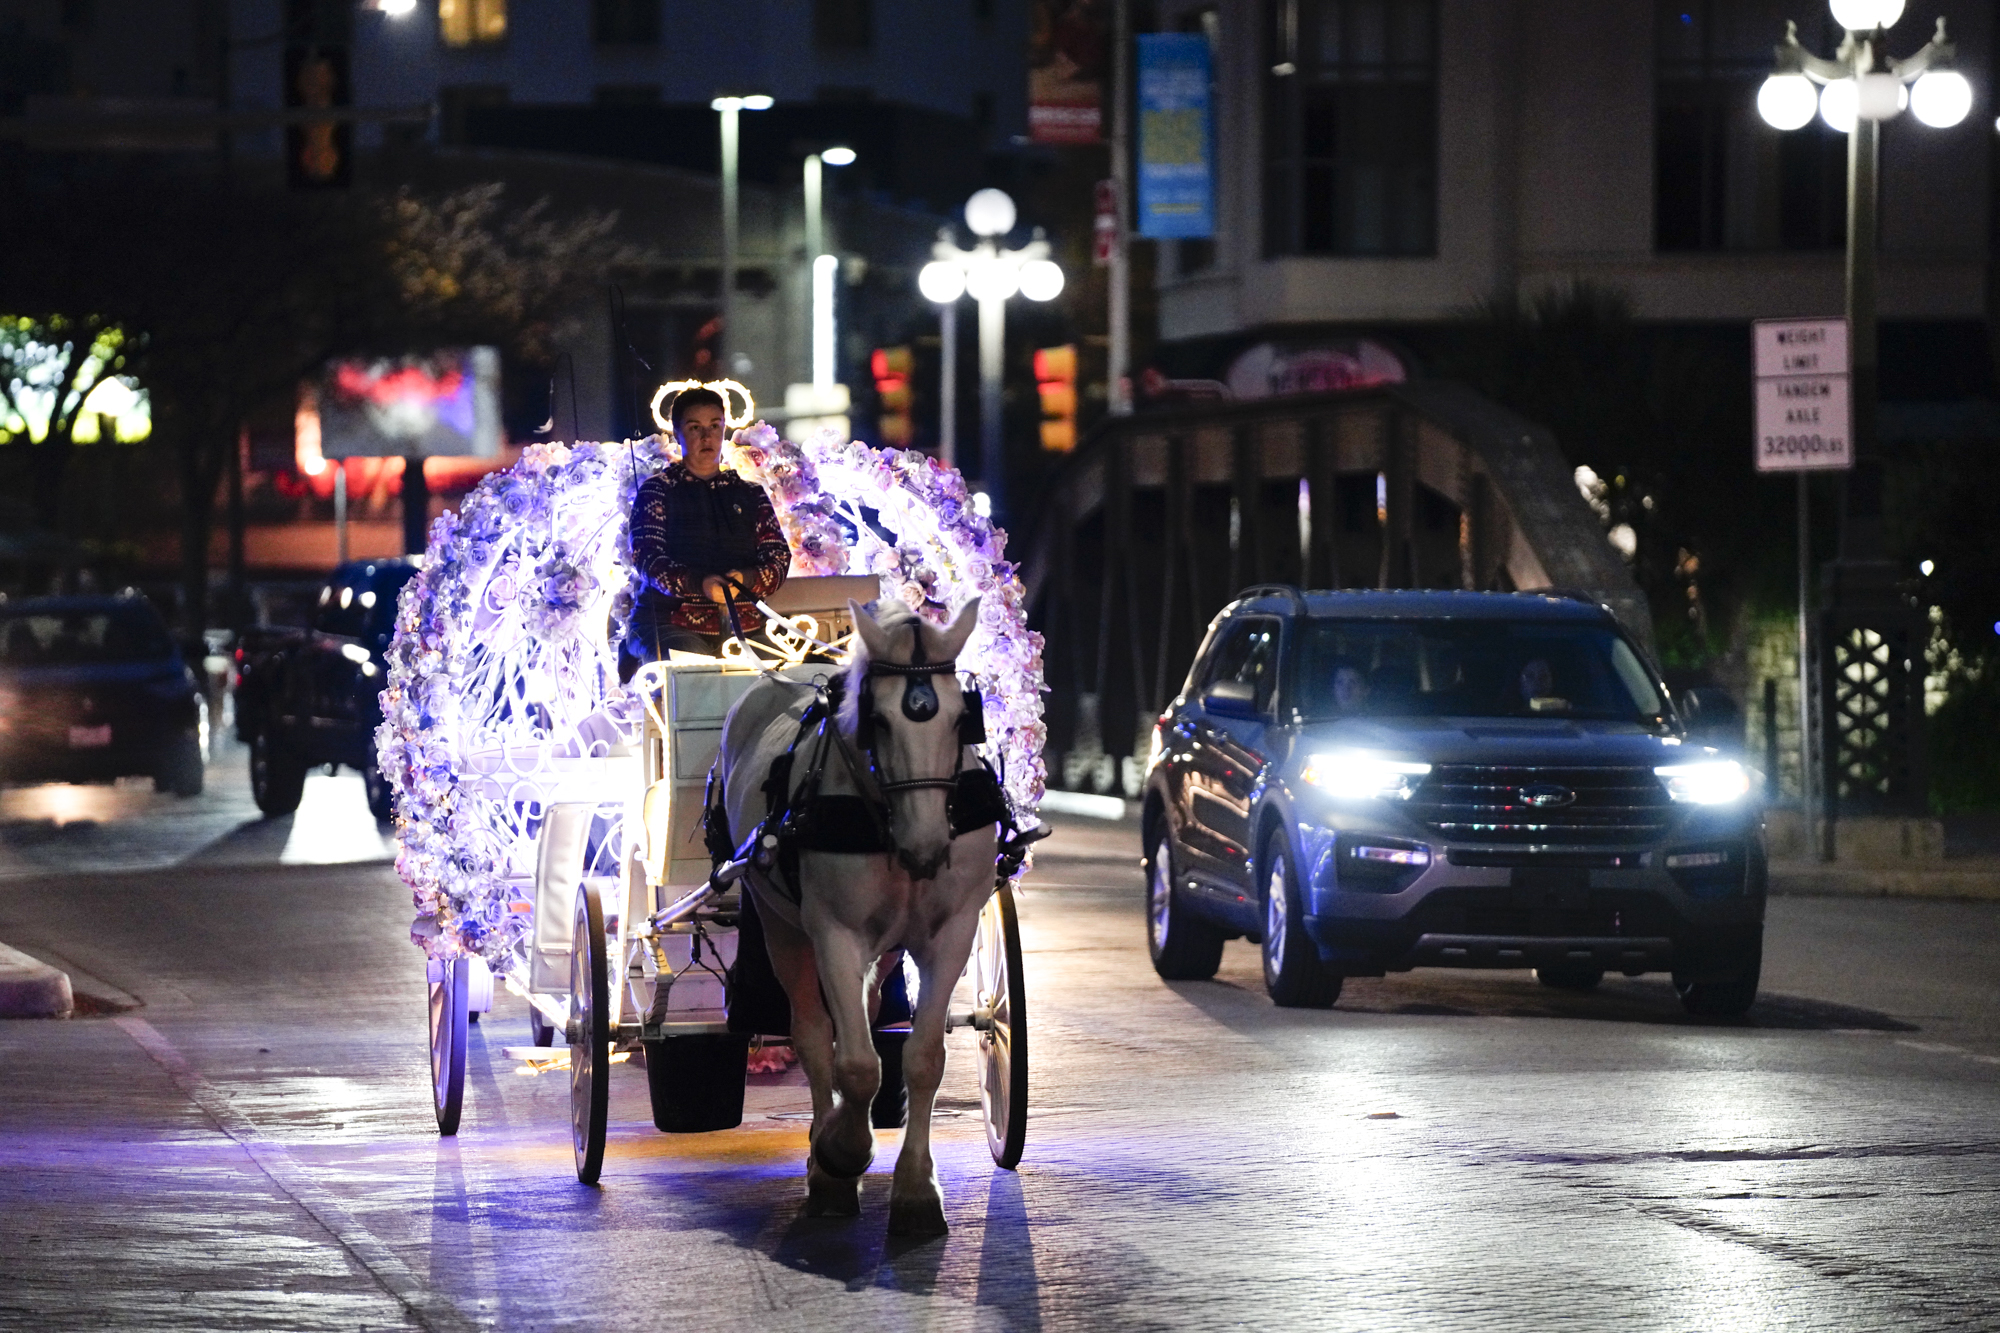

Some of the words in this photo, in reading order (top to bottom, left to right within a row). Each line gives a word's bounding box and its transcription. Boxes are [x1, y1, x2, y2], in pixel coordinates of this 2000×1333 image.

[1777, 328, 1825, 344] WEIGHT
[1783, 354, 1818, 370] LIMIT
[1777, 383, 1831, 398] TANDEM
[1786, 407, 1820, 423] AXLE
[1764, 435, 1821, 454] 32000
